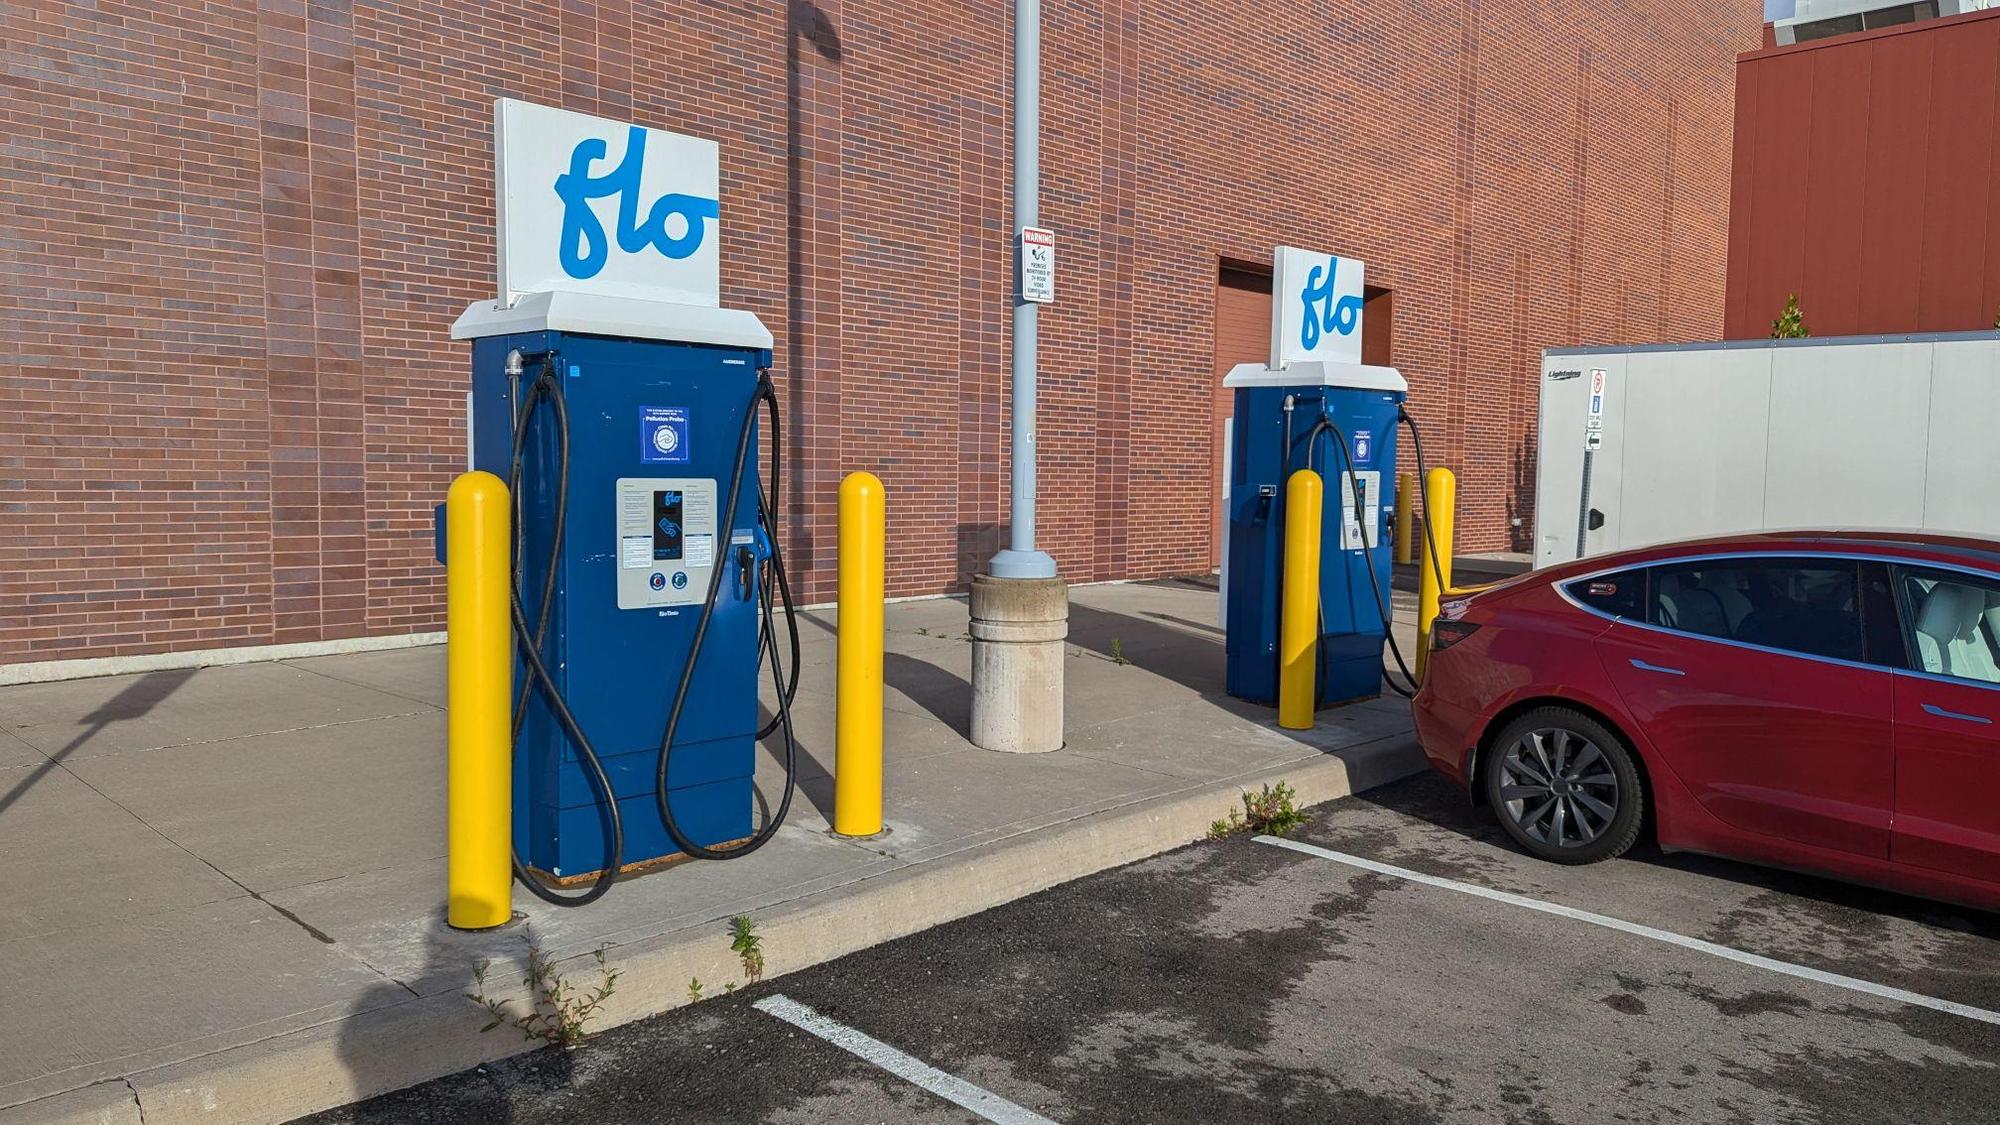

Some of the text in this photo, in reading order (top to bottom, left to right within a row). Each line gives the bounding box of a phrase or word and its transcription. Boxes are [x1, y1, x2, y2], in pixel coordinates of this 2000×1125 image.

[554, 125, 719, 280] flo
[1024, 230, 1053, 245] WARNING
[1301, 256, 1363, 351] flo
[1548, 370, 1581, 378] Lightning
[664, 490, 682, 506] flo
